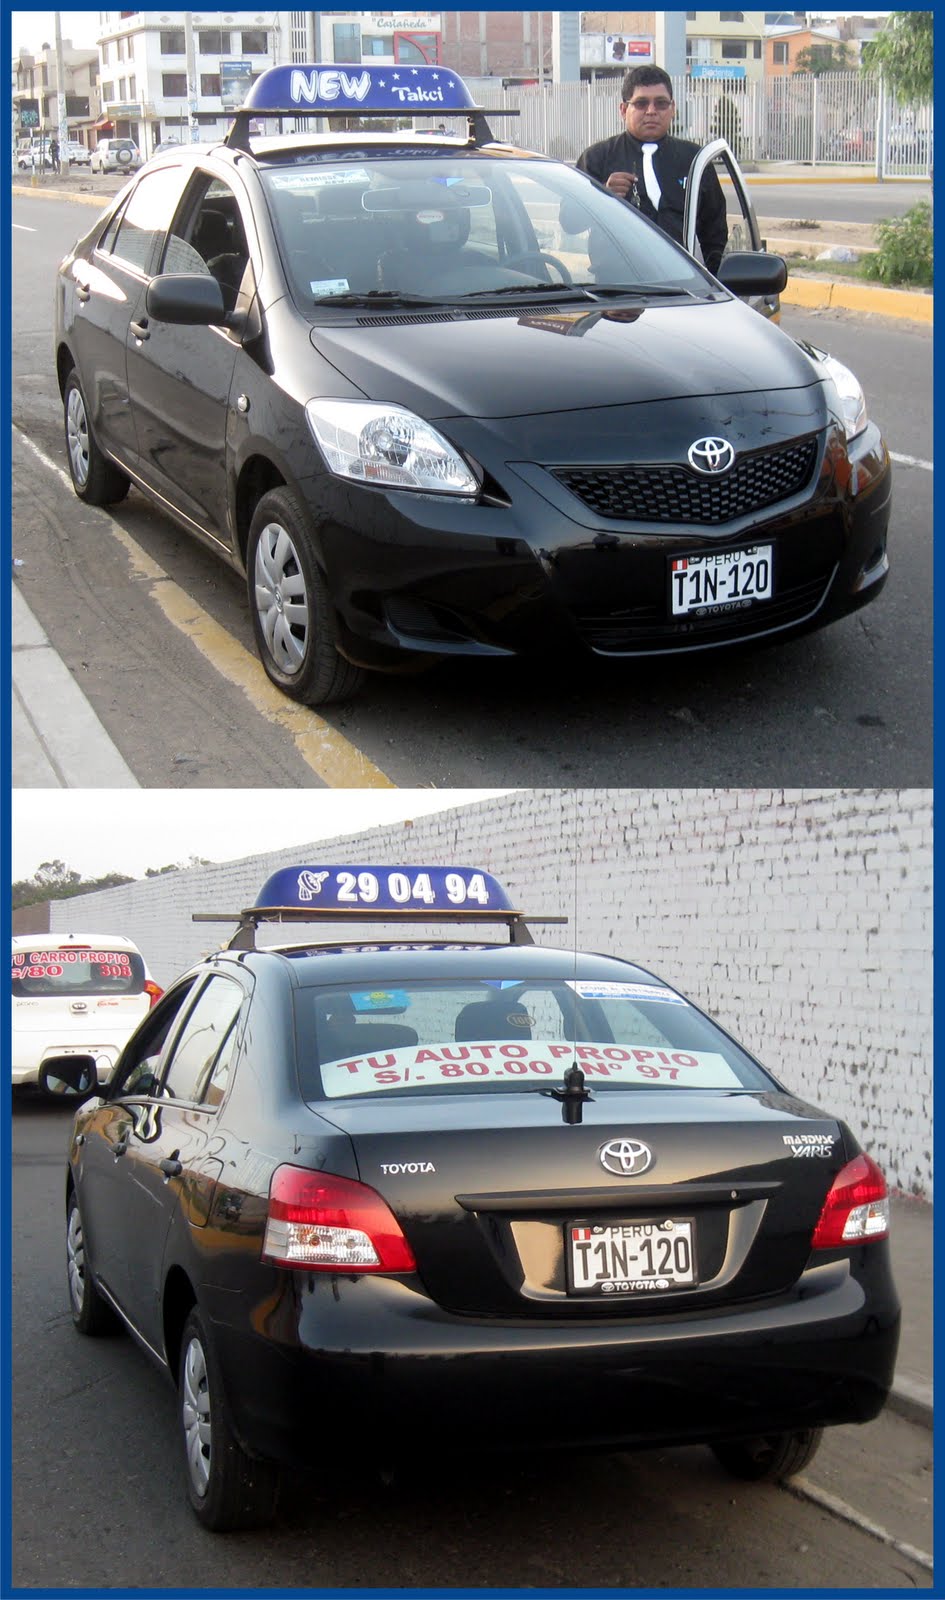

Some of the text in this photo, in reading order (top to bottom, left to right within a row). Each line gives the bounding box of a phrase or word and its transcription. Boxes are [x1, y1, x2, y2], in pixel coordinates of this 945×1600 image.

[290, 69, 372, 103] NEW
[391, 86, 444, 102] Takci
[705, 552, 741, 566] PERU
[674, 559, 768, 606] T1N-120
[707, 601, 741, 614] TOYOTA
[336, 872, 489, 905] 29 04 94
[30, 952, 77, 964] CARRO
[79, 952, 130, 965] PROPIO
[100, 964, 132, 977] 308
[337, 1044, 699, 1074] TU AUTO PROPIO
[439, 1060, 554, 1077] 80.00
[635, 1065, 681, 1080] 97
[380, 1162, 436, 1174] TOYOTA
[610, 1225, 653, 1238] PERU
[575, 1236, 690, 1280] T1N-120
[614, 1280, 657, 1291] TOYOTA
